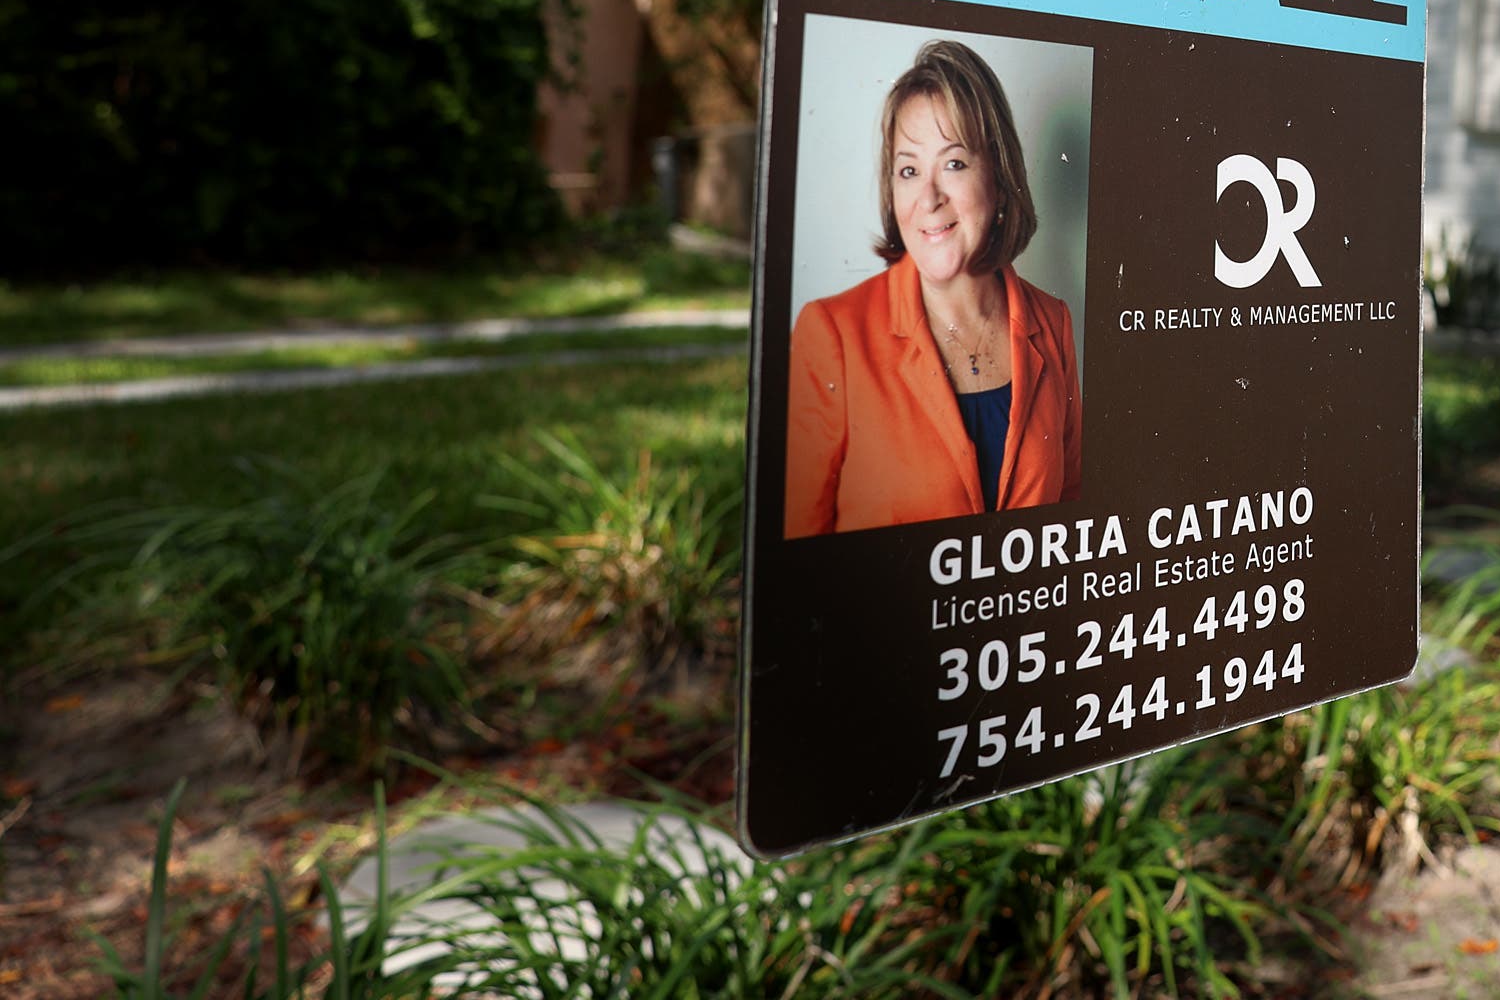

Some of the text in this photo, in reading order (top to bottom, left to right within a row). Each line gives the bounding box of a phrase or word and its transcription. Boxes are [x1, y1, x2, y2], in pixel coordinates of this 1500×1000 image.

[1119, 301, 1396, 332] CR REALTY & MANAGEMENT LLC
[929, 486, 1315, 586] GLORIA CATANO
[931, 534, 1314, 631] Licensed Real Estate Agent
[937, 578, 1307, 701] 305.244.4498
[937, 642, 1306, 780] 754.244.1944
